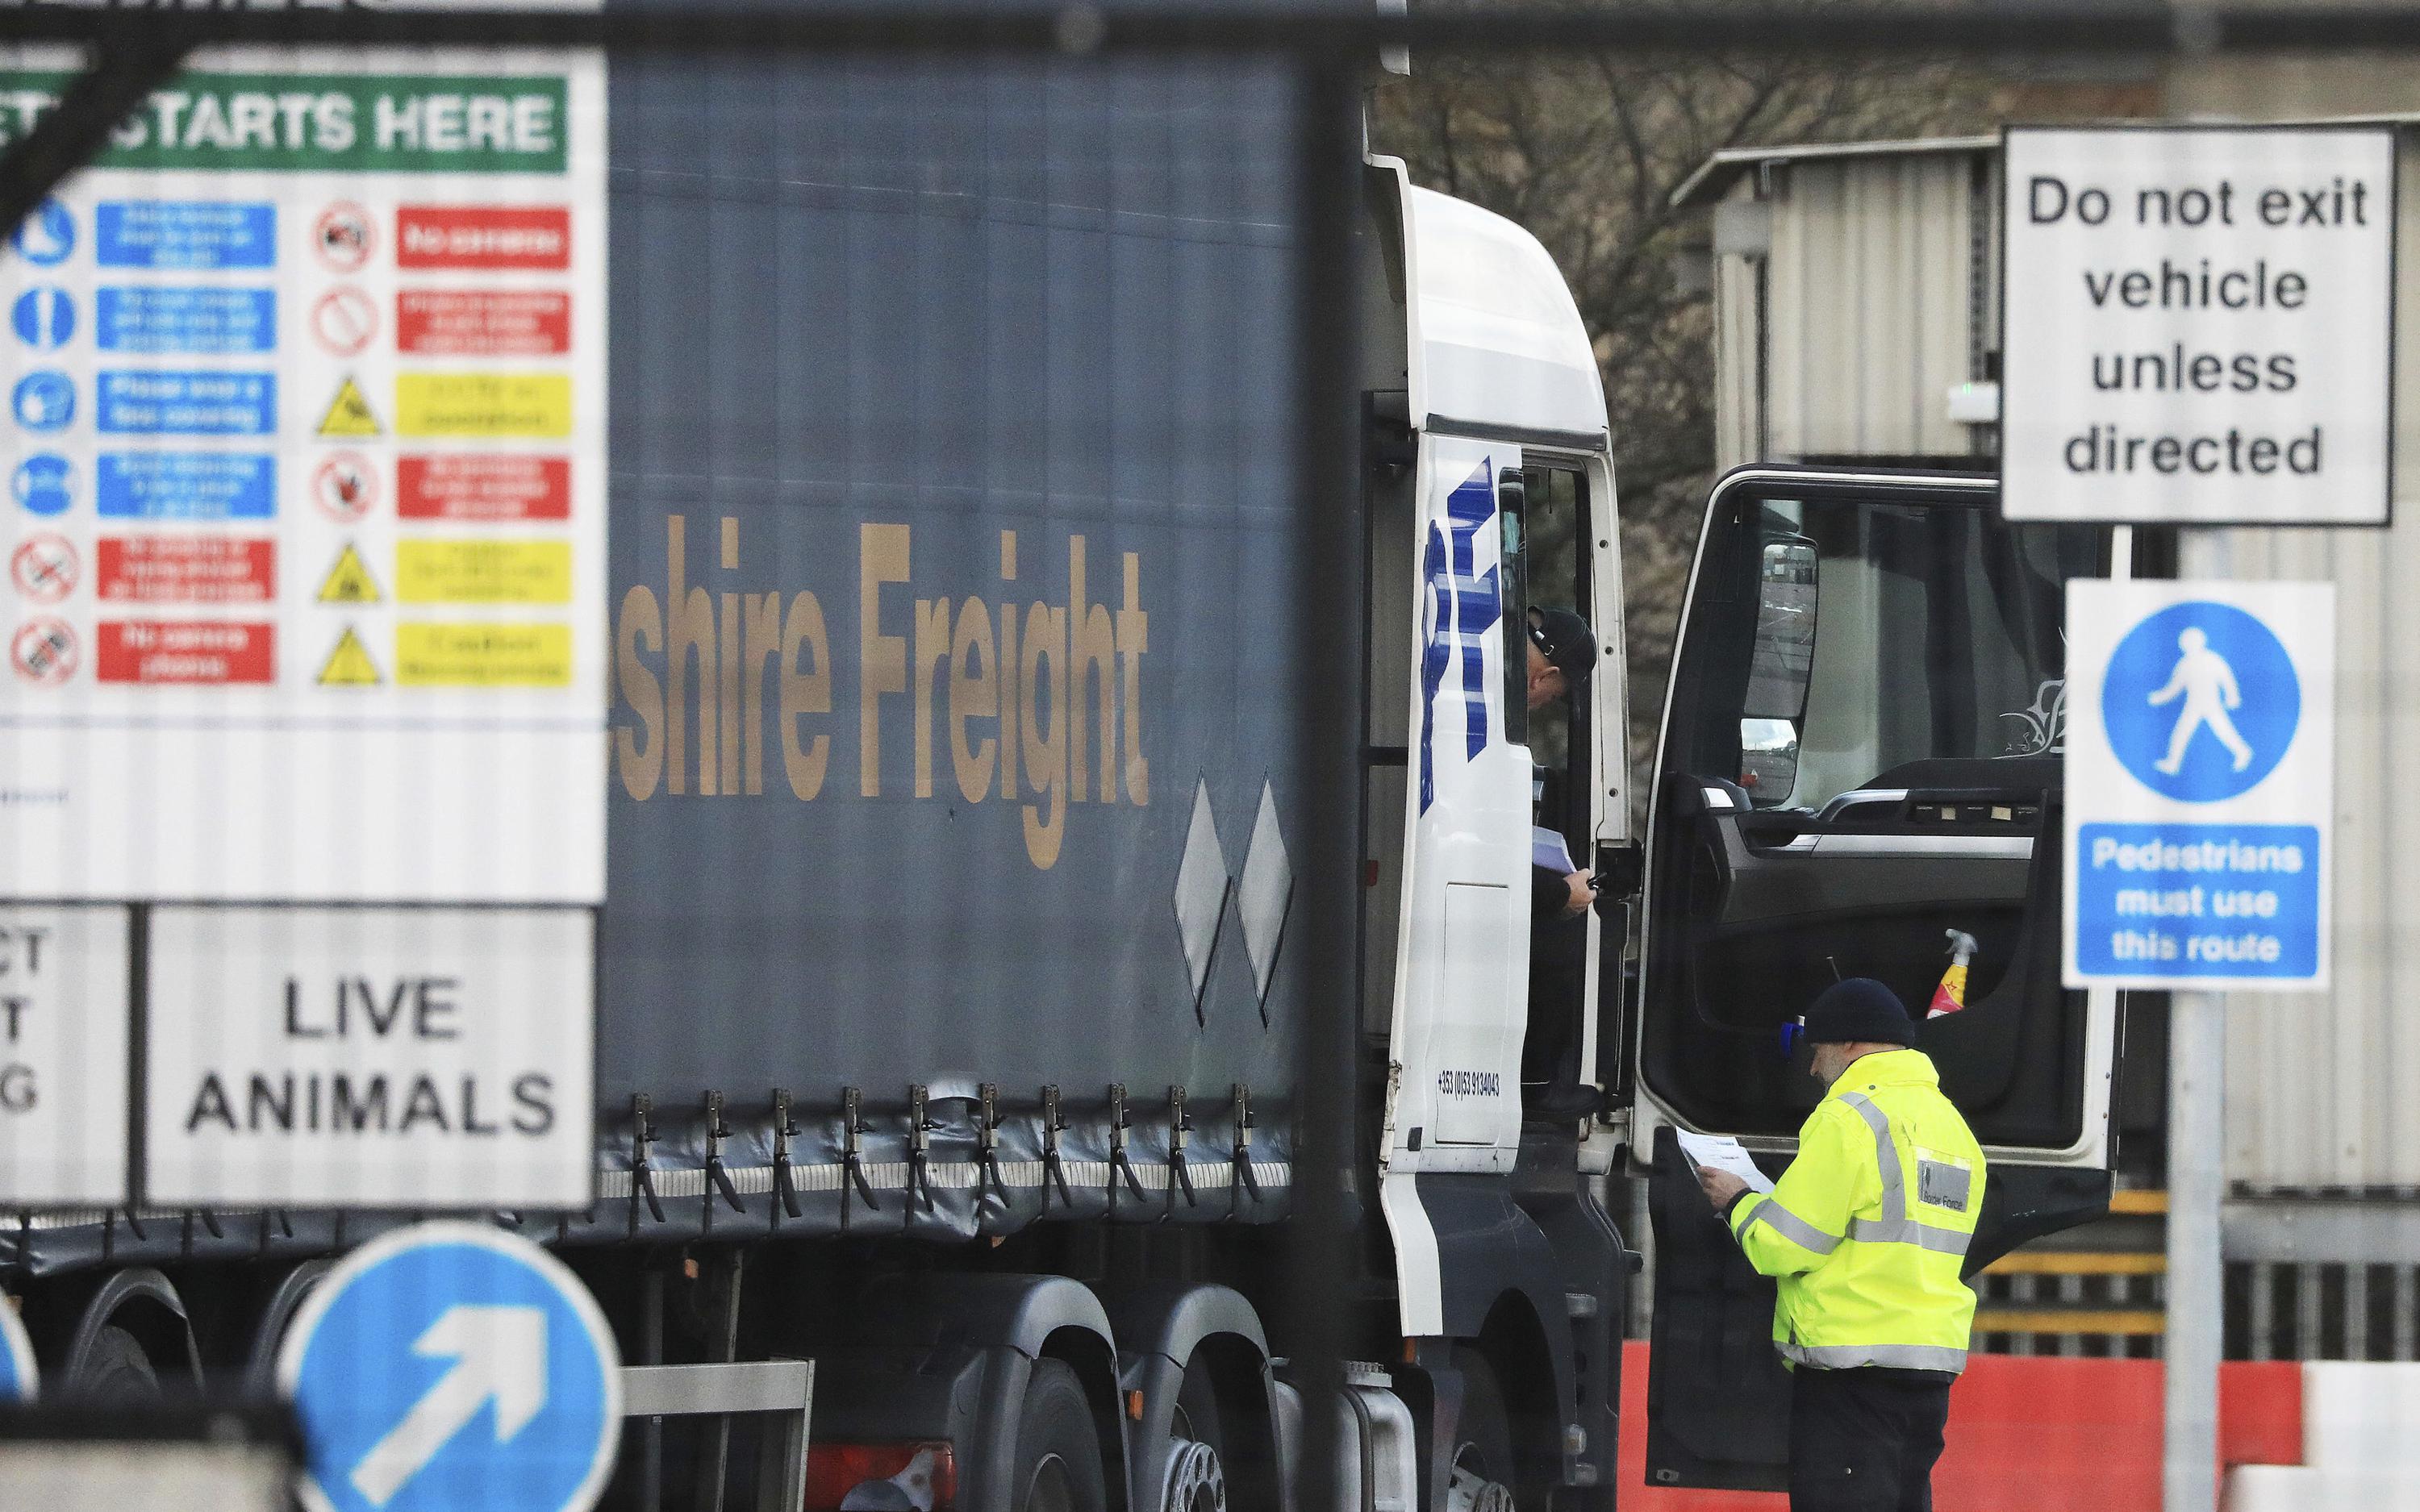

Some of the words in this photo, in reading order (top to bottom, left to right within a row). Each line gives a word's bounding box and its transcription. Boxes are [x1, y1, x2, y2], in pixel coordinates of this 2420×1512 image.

[109, 90, 357, 152] STARTS
[372, 92, 557, 153] HERE
[2026, 173, 2113, 227] Do
[2135, 178, 2235, 228] not
[2257, 176, 2369, 228] exit
[2083, 257, 2309, 311] vehicle
[2091, 340, 2299, 394] unless
[2062, 423, 2323, 477] directed
[607, 514, 831, 801] shire
[860, 523, 1149, 870] Freight
[2092, 836, 2305, 874] Pedestrians
[2115, 885, 2205, 917] must
[2212, 889, 2280, 918] use
[2111, 930, 2178, 960] this
[2186, 933, 2282, 963] route
[282, 976, 460, 1041] LIVE
[183, 1068, 557, 1138] ANIMALS
[1438, 1069, 1454, 1094] +353
[1454, 1070, 1471, 1102] (0)53
[1471, 1071, 1500, 1098] 9134043
[1942, 1195, 1963, 1210] Force
